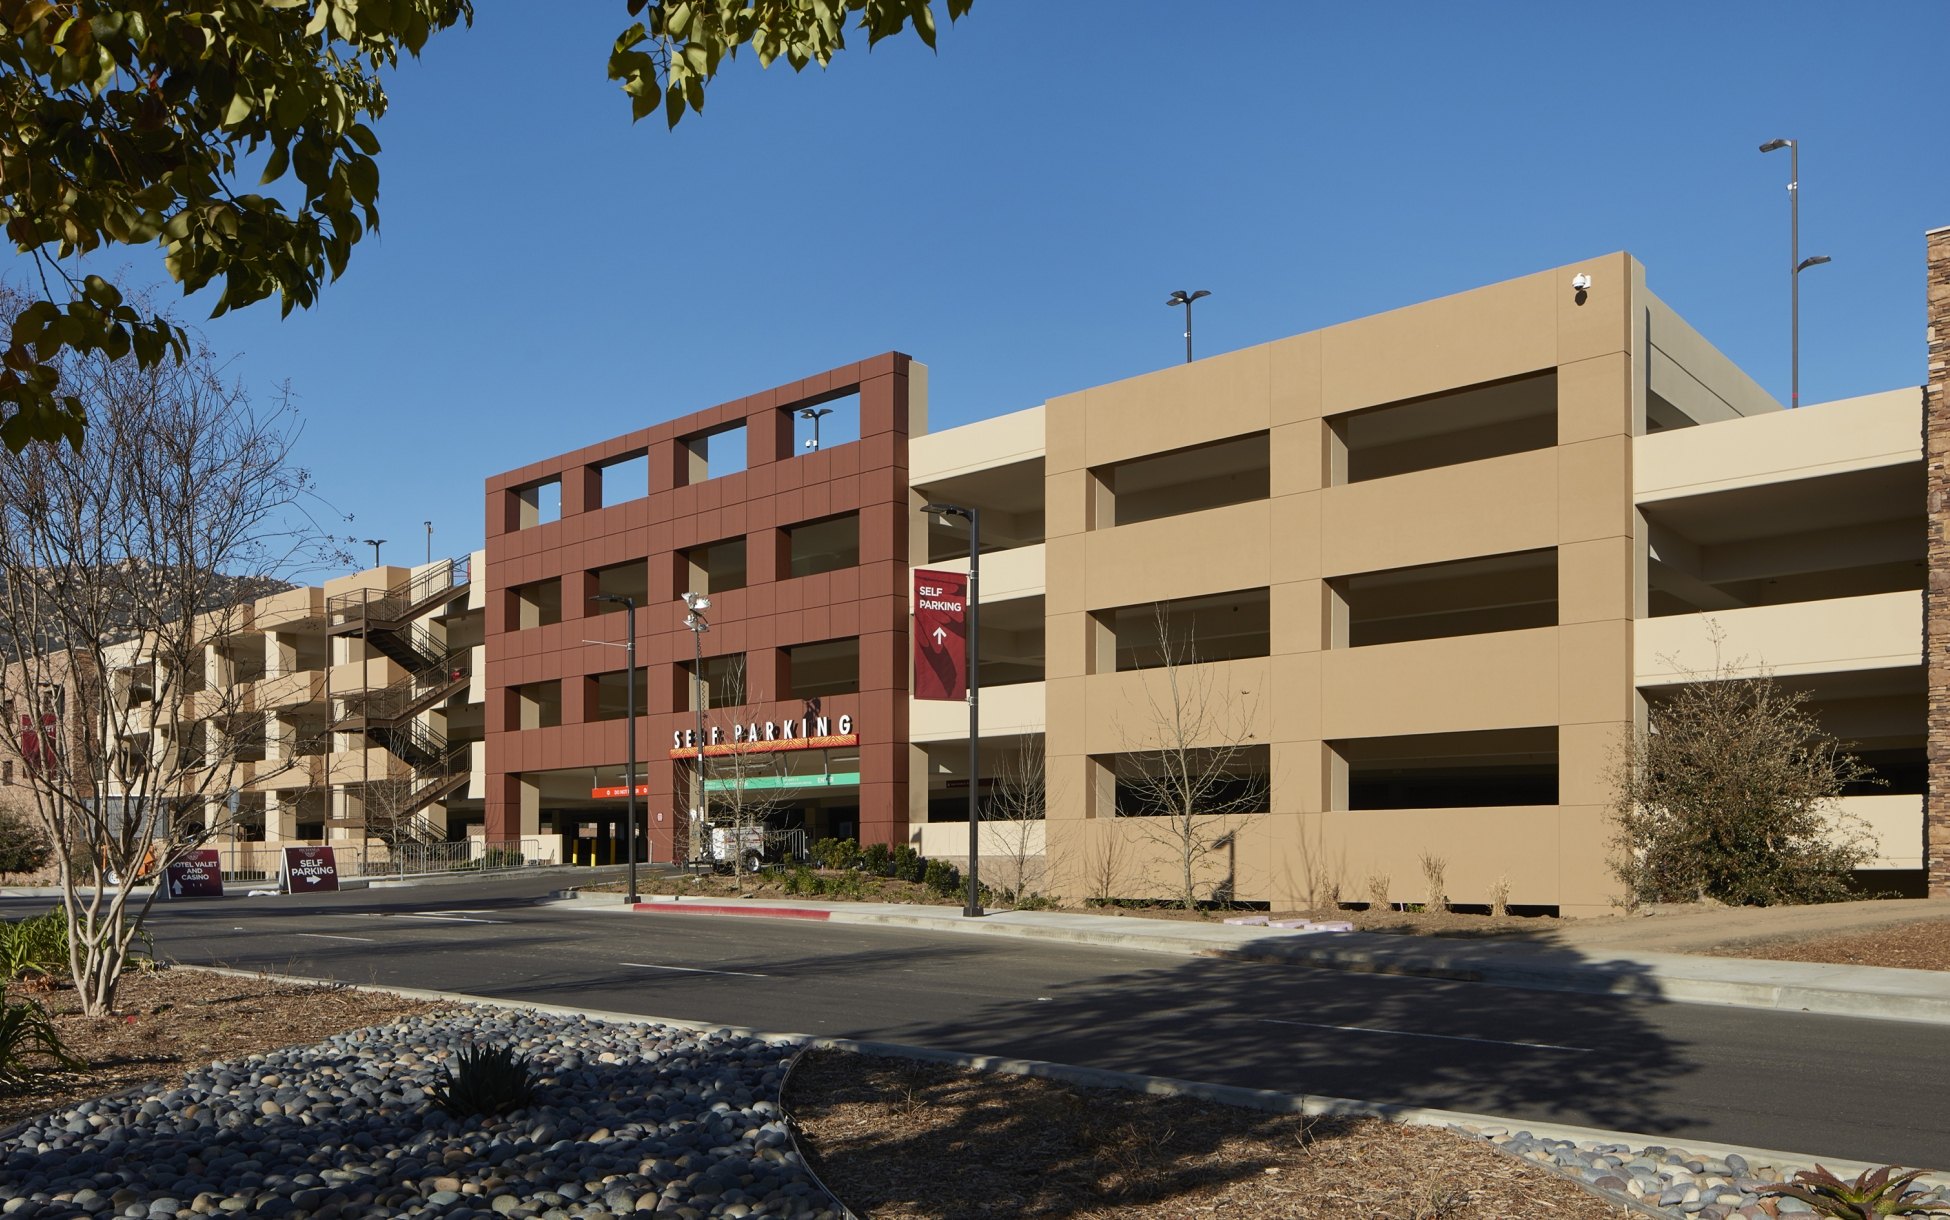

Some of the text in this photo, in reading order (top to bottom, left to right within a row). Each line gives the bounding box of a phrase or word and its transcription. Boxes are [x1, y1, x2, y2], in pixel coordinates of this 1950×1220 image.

[919, 586, 943, 597] SELF
[919, 599, 962, 612] PARKING
[674, 714, 852, 749] SEF PARKING
[300, 859, 323, 868] SELF
[291, 867, 334, 876] PARKING
